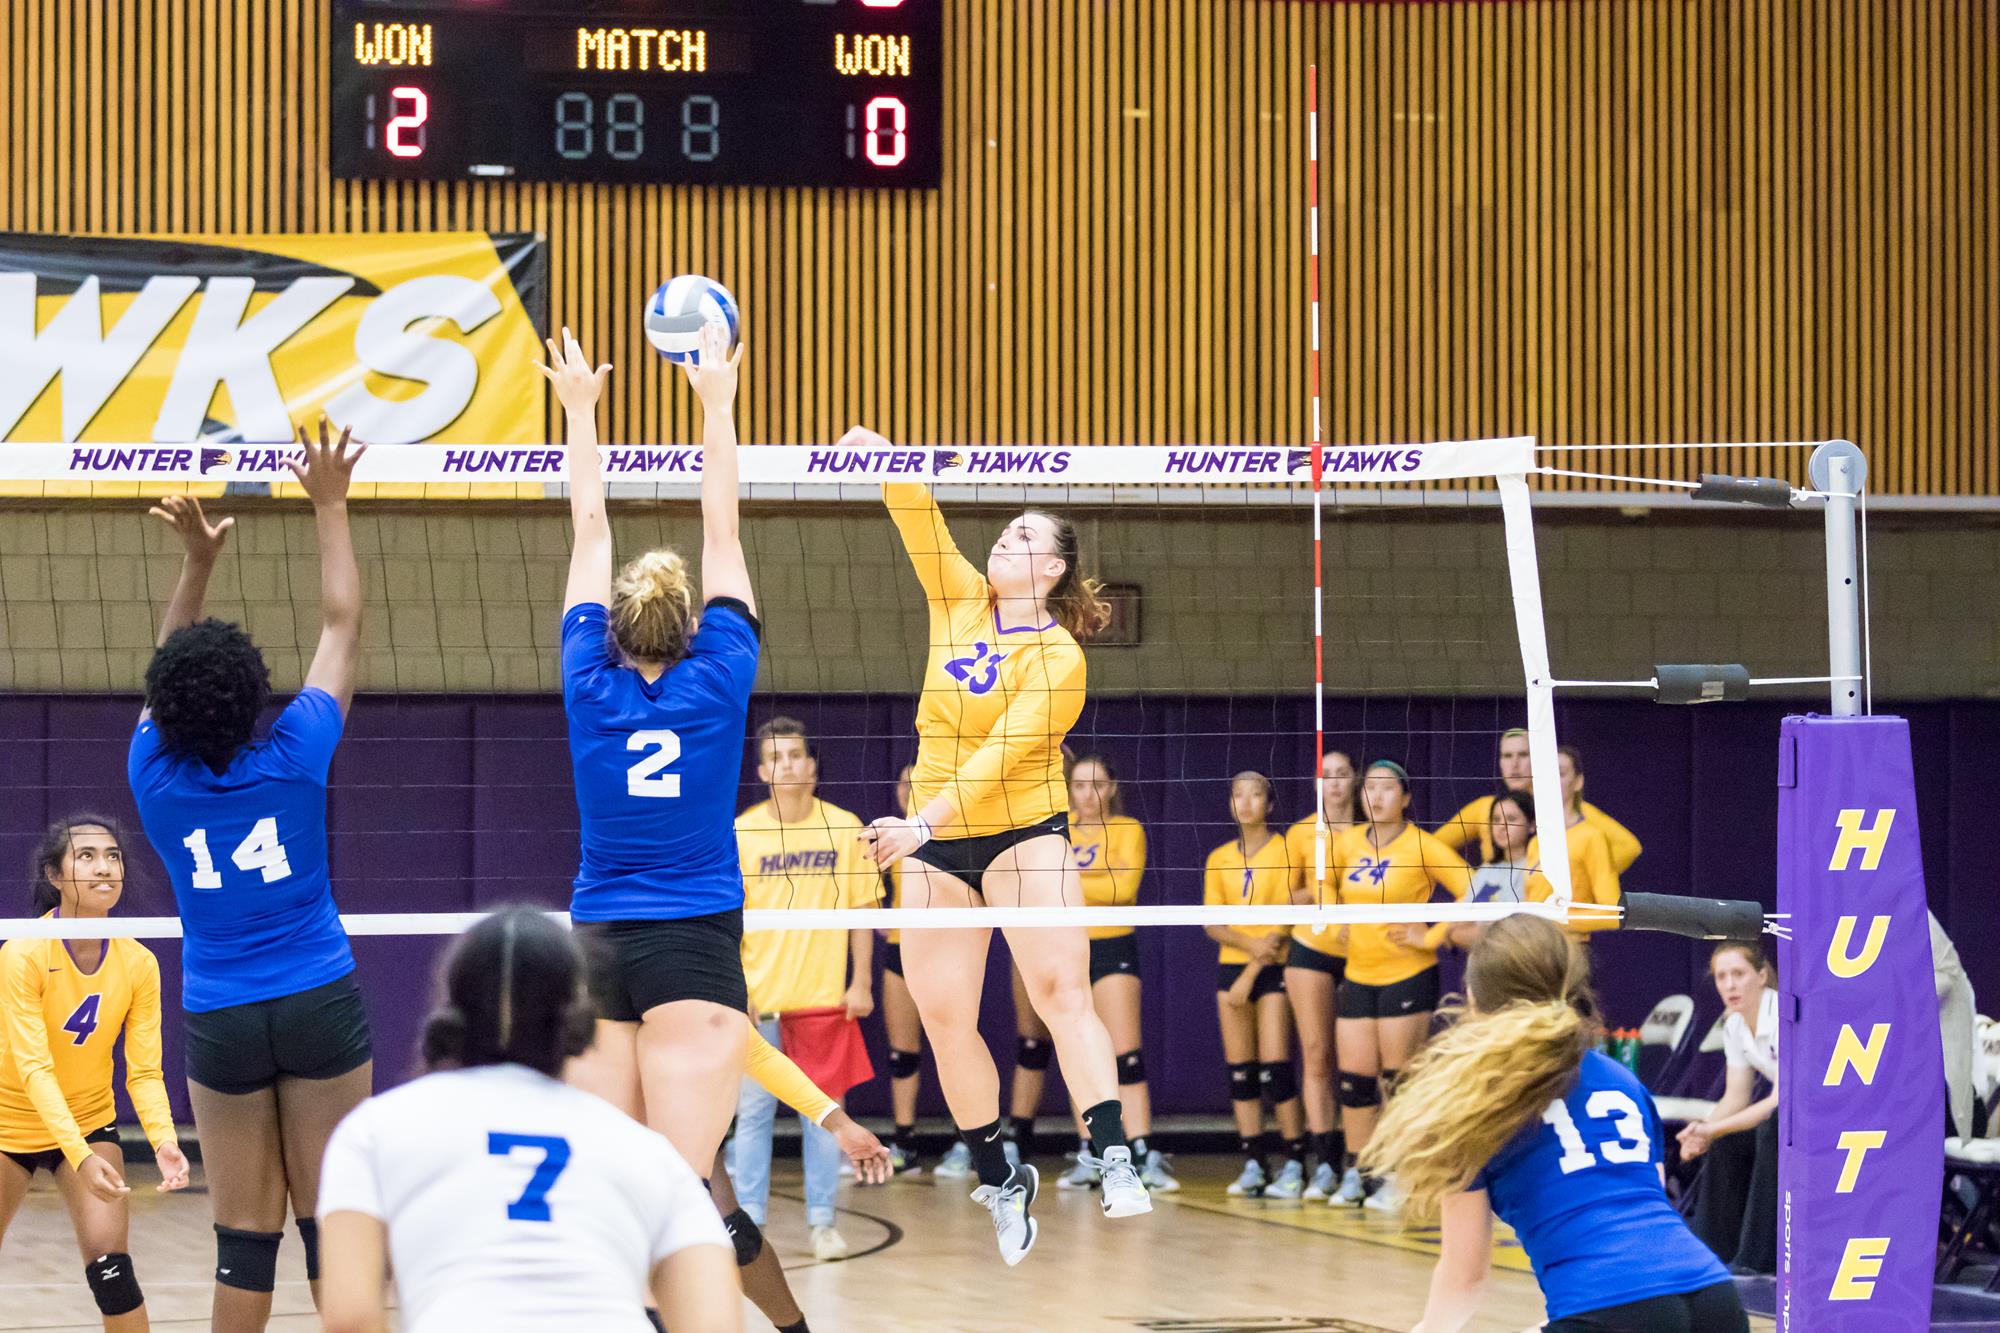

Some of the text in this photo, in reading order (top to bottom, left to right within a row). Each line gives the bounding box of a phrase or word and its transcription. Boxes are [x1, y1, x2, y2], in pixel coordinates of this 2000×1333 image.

[355, 22, 433, 66] WON
[576, 28, 706, 71] MATCH
[834, 33, 910, 76] WON
[0, 272, 503, 444] WKS
[69, 448, 309, 472] HUNTER HAW
[442, 450, 564, 473] HUNTER
[807, 450, 1072, 474] HUNTER HAWKS
[1164, 449, 1423, 473] HUNTER HAWKS
[626, 729, 681, 798] 2
[183, 816, 293, 890] 14
[760, 848, 838, 874] HUNTER
[1348, 857, 1391, 886] 24
[60, 992, 104, 1047] 4
[1542, 1090, 1651, 1175] 13
[487, 1131, 572, 1223] 7
[1783, 1190, 1792, 1274] sports
